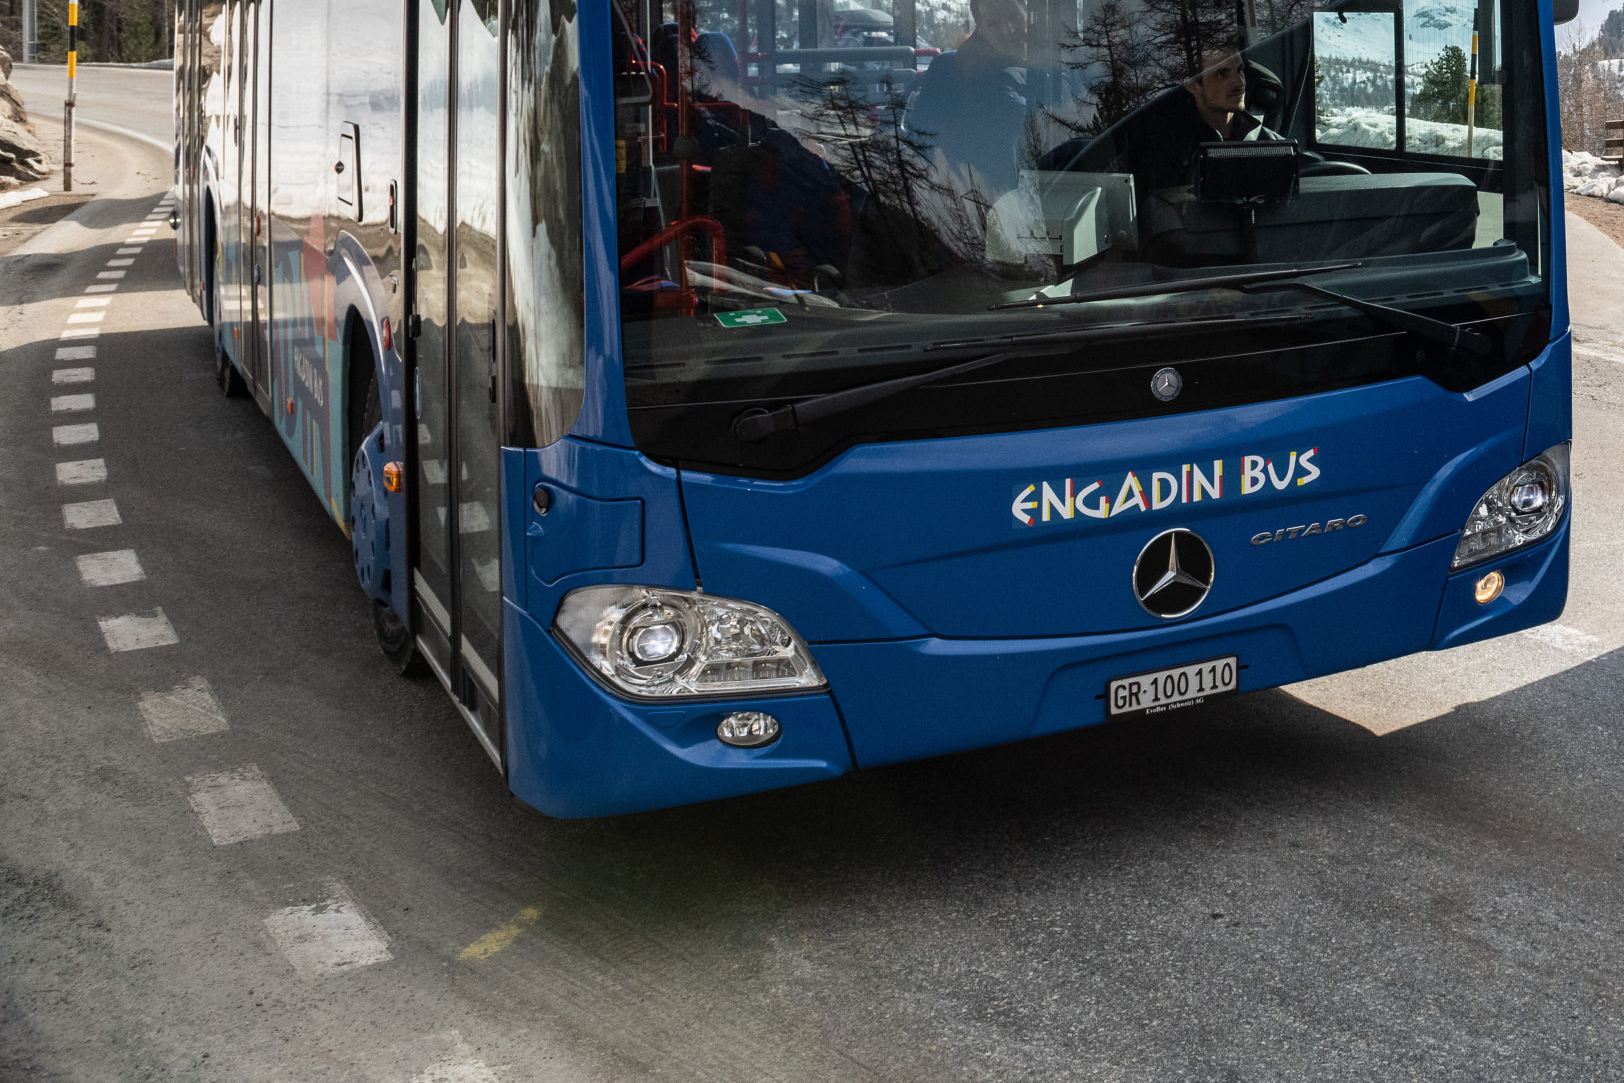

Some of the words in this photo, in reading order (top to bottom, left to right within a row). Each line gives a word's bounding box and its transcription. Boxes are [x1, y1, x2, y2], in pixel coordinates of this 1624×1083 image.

[1011, 459, 1223, 527] ENGADIN
[1240, 446, 1321, 495] BUS
[1250, 513, 1368, 546] CITARO
[1195, 662, 1233, 693] 110
